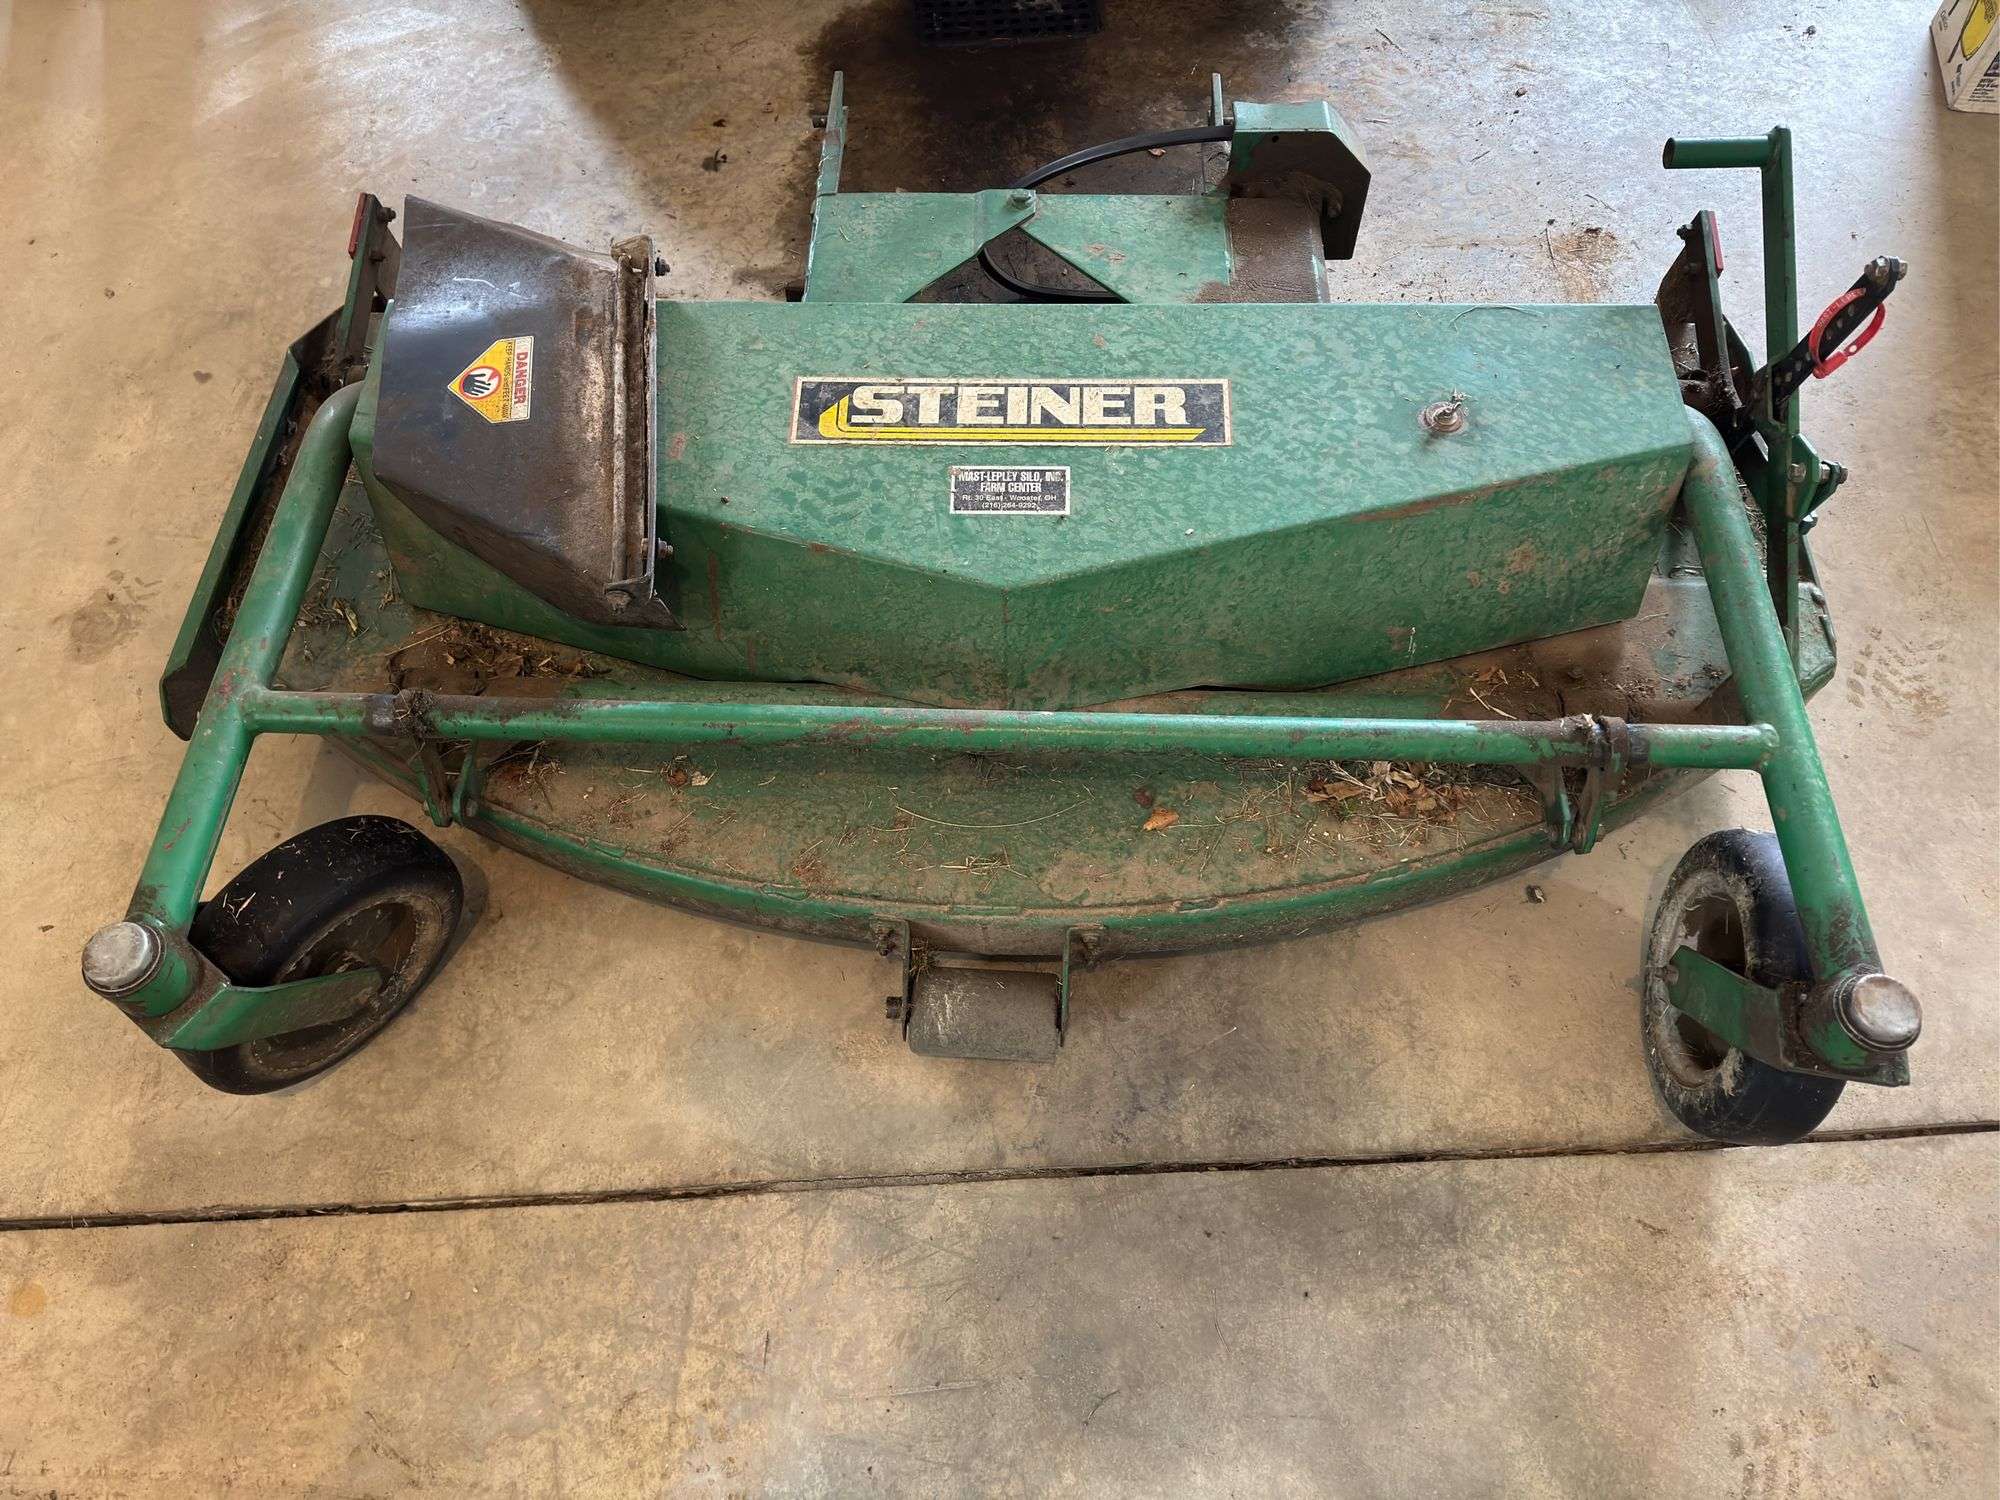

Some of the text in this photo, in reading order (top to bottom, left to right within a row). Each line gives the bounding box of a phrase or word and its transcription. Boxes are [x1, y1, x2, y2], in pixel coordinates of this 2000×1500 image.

[505, 342, 513, 355] KEEP
[514, 352, 528, 404] DANGER
[850, 386, 1190, 425] STEINER
[959, 472, 1018, 482] MAST-LEPLEY
[980, 482, 1042, 493] FARM CENTER
